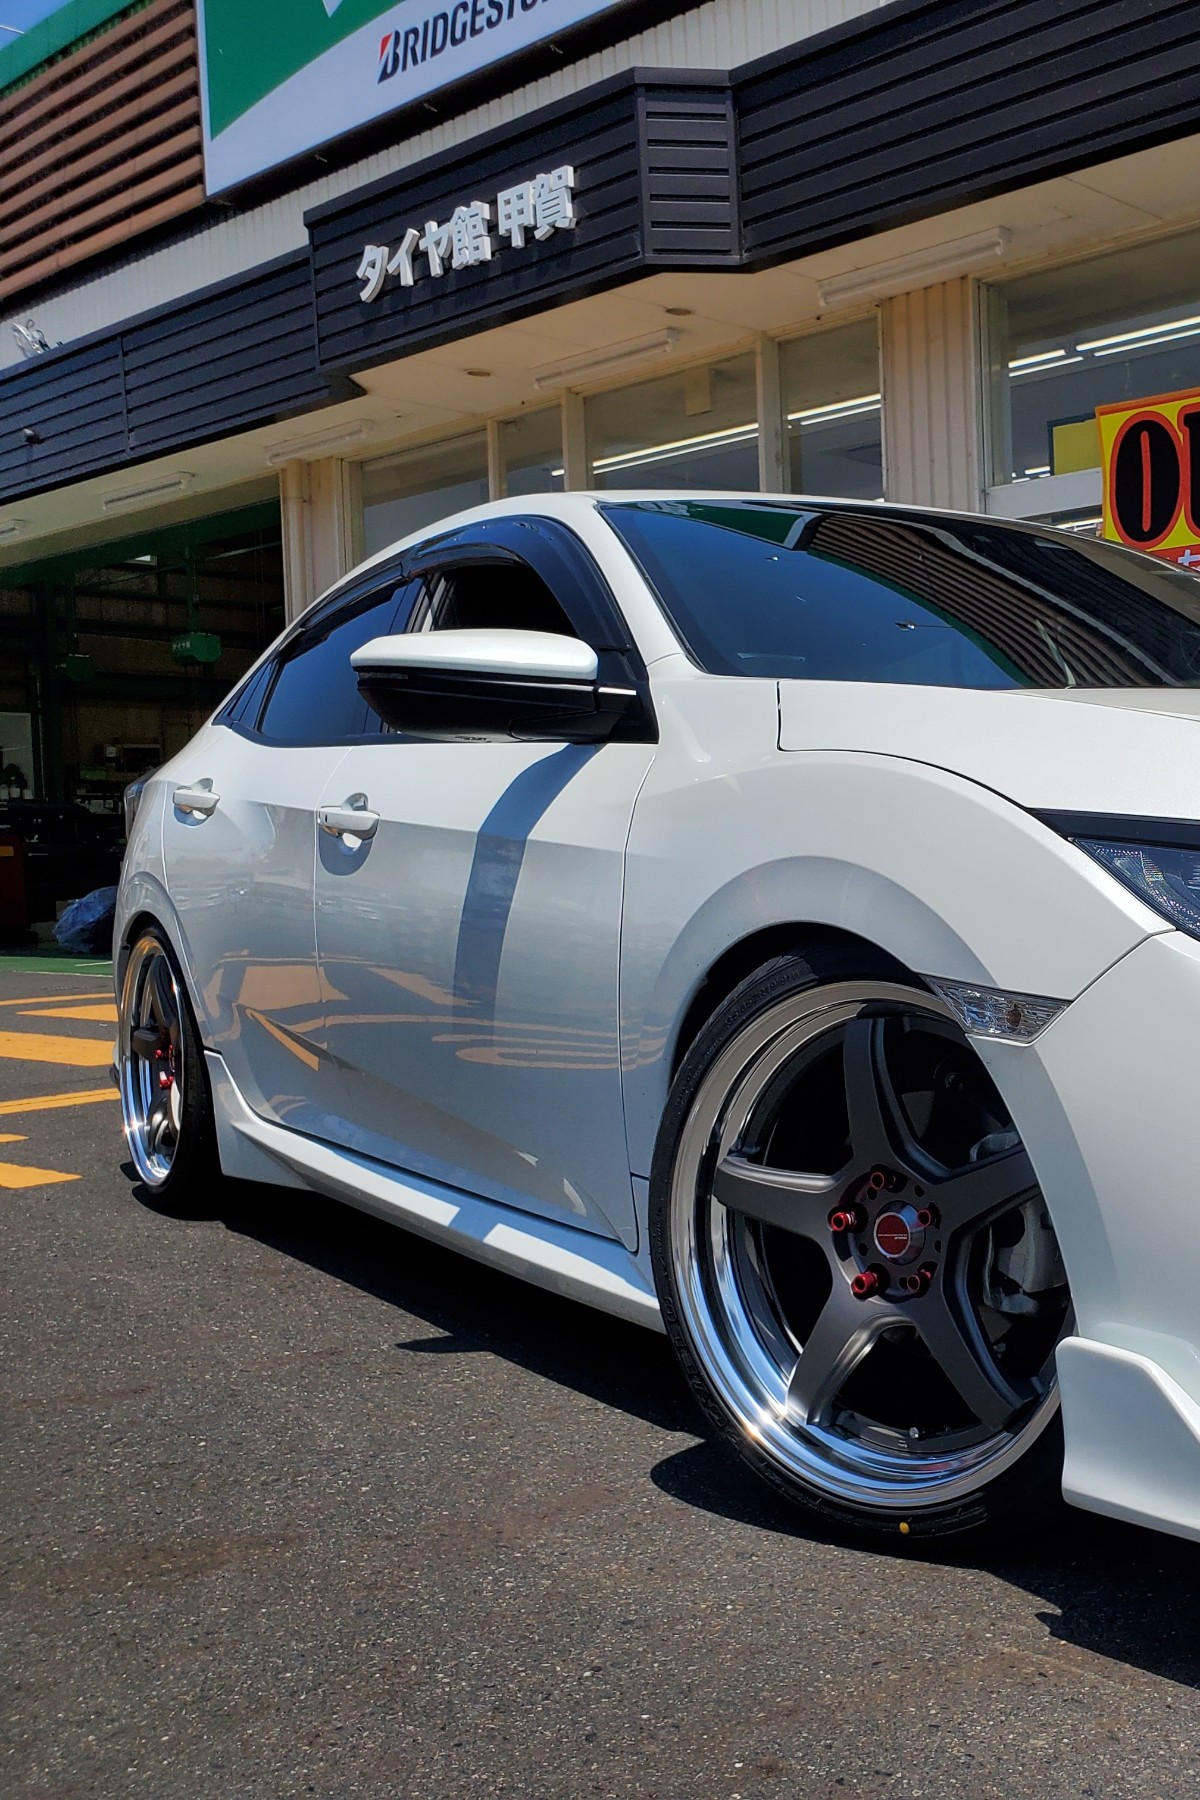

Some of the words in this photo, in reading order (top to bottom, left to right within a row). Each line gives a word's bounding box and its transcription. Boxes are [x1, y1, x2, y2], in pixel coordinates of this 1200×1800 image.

[356, 200, 492, 303] タイヤ館
[497, 164, 577, 249] 甲賀
